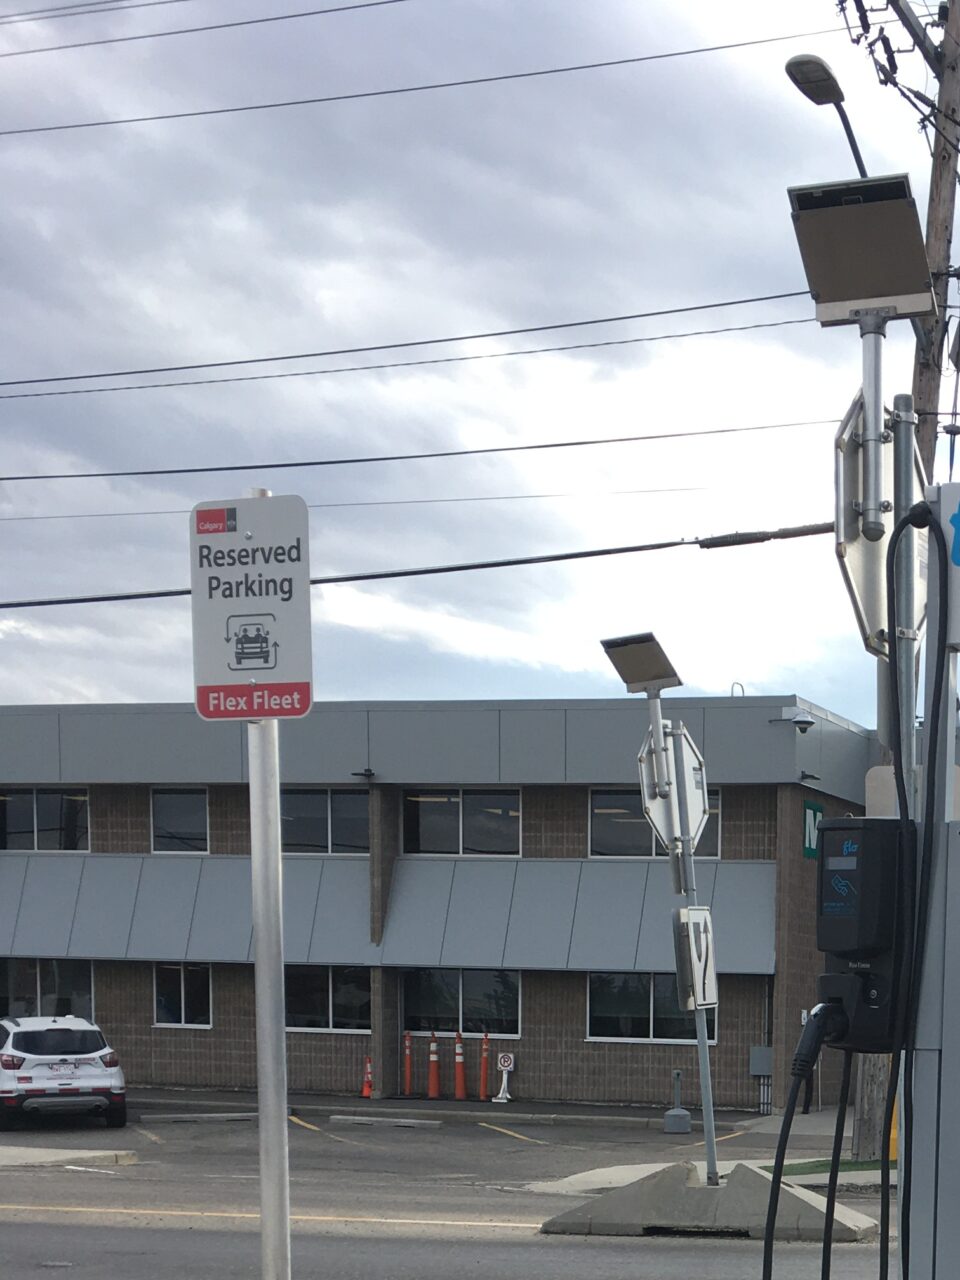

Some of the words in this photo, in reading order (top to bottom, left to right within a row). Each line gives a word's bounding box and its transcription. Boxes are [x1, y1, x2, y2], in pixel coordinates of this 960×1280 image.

[199, 519, 224, 531] Calgary
[198, 537, 301, 568] Reserved
[208, 573, 293, 602] Parking
[208, 692, 247, 711] Flex
[253, 690, 301, 710] Fleet
